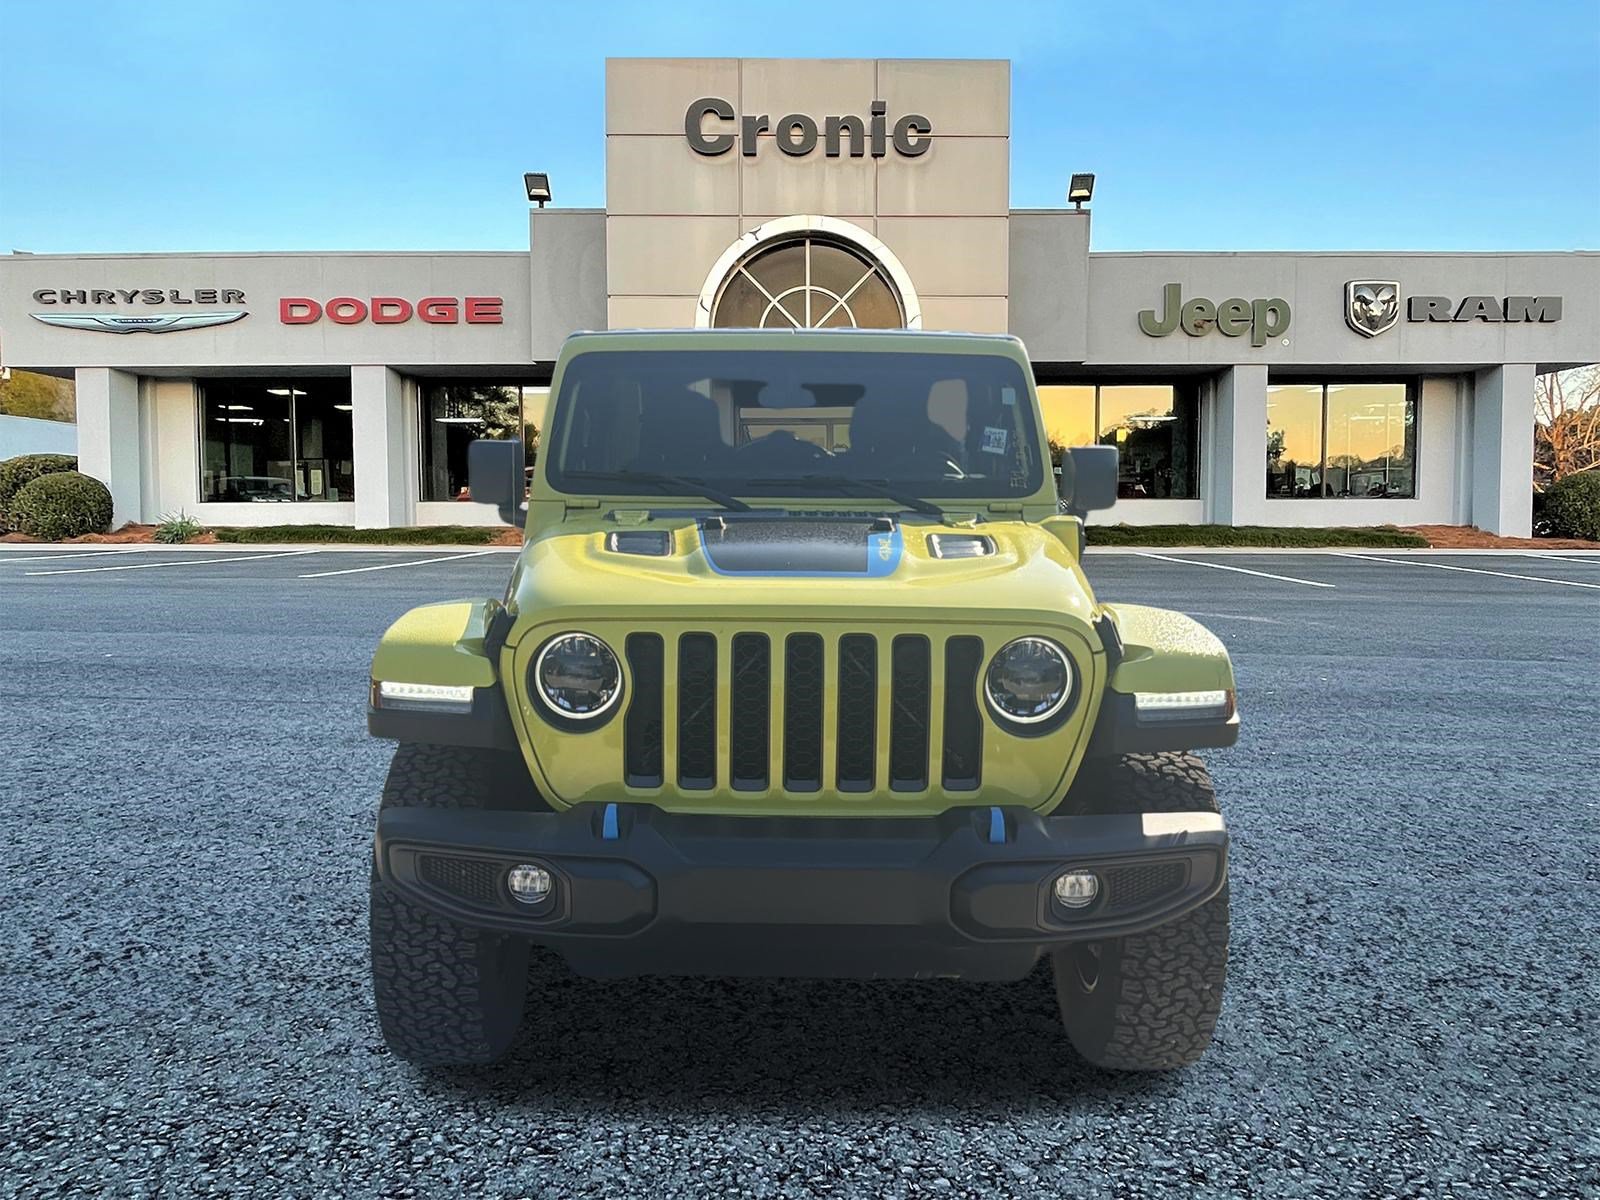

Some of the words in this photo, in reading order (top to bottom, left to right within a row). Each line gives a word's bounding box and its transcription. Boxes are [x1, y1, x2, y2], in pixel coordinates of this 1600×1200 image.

[685, 97, 932, 158] Cronic
[32, 288, 246, 305] CHRYSLER
[1407, 296, 1563, 322] RAM
[279, 297, 503, 325] DODGE
[1138, 283, 1291, 348] Jeep
